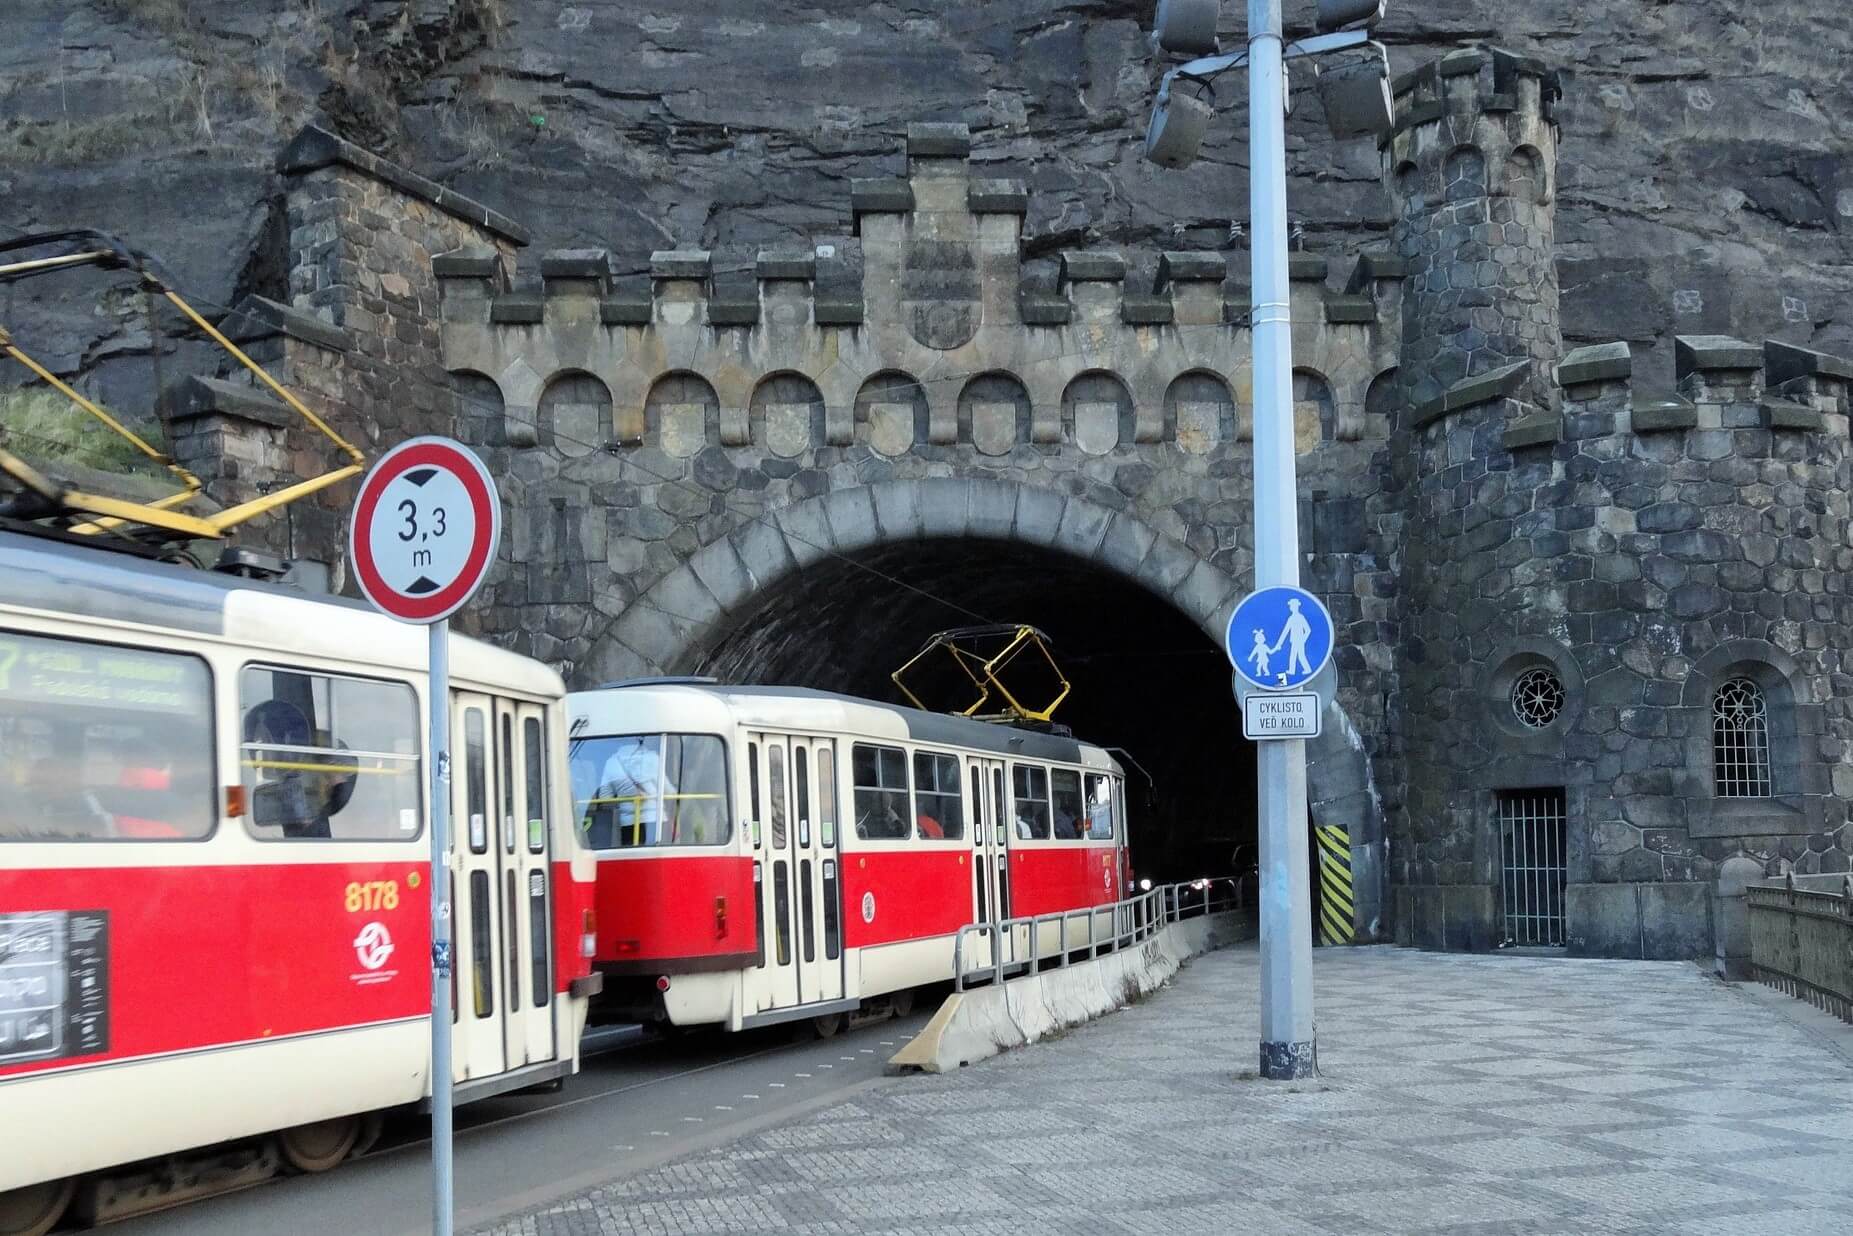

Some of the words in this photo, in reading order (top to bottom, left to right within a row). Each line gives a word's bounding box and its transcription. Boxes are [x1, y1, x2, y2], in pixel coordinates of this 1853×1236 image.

[398, 499, 446, 543] 3,3
[413, 549, 432, 567] m
[1281, 717, 1305, 729] KOLO
[345, 881, 399, 912] 8178
